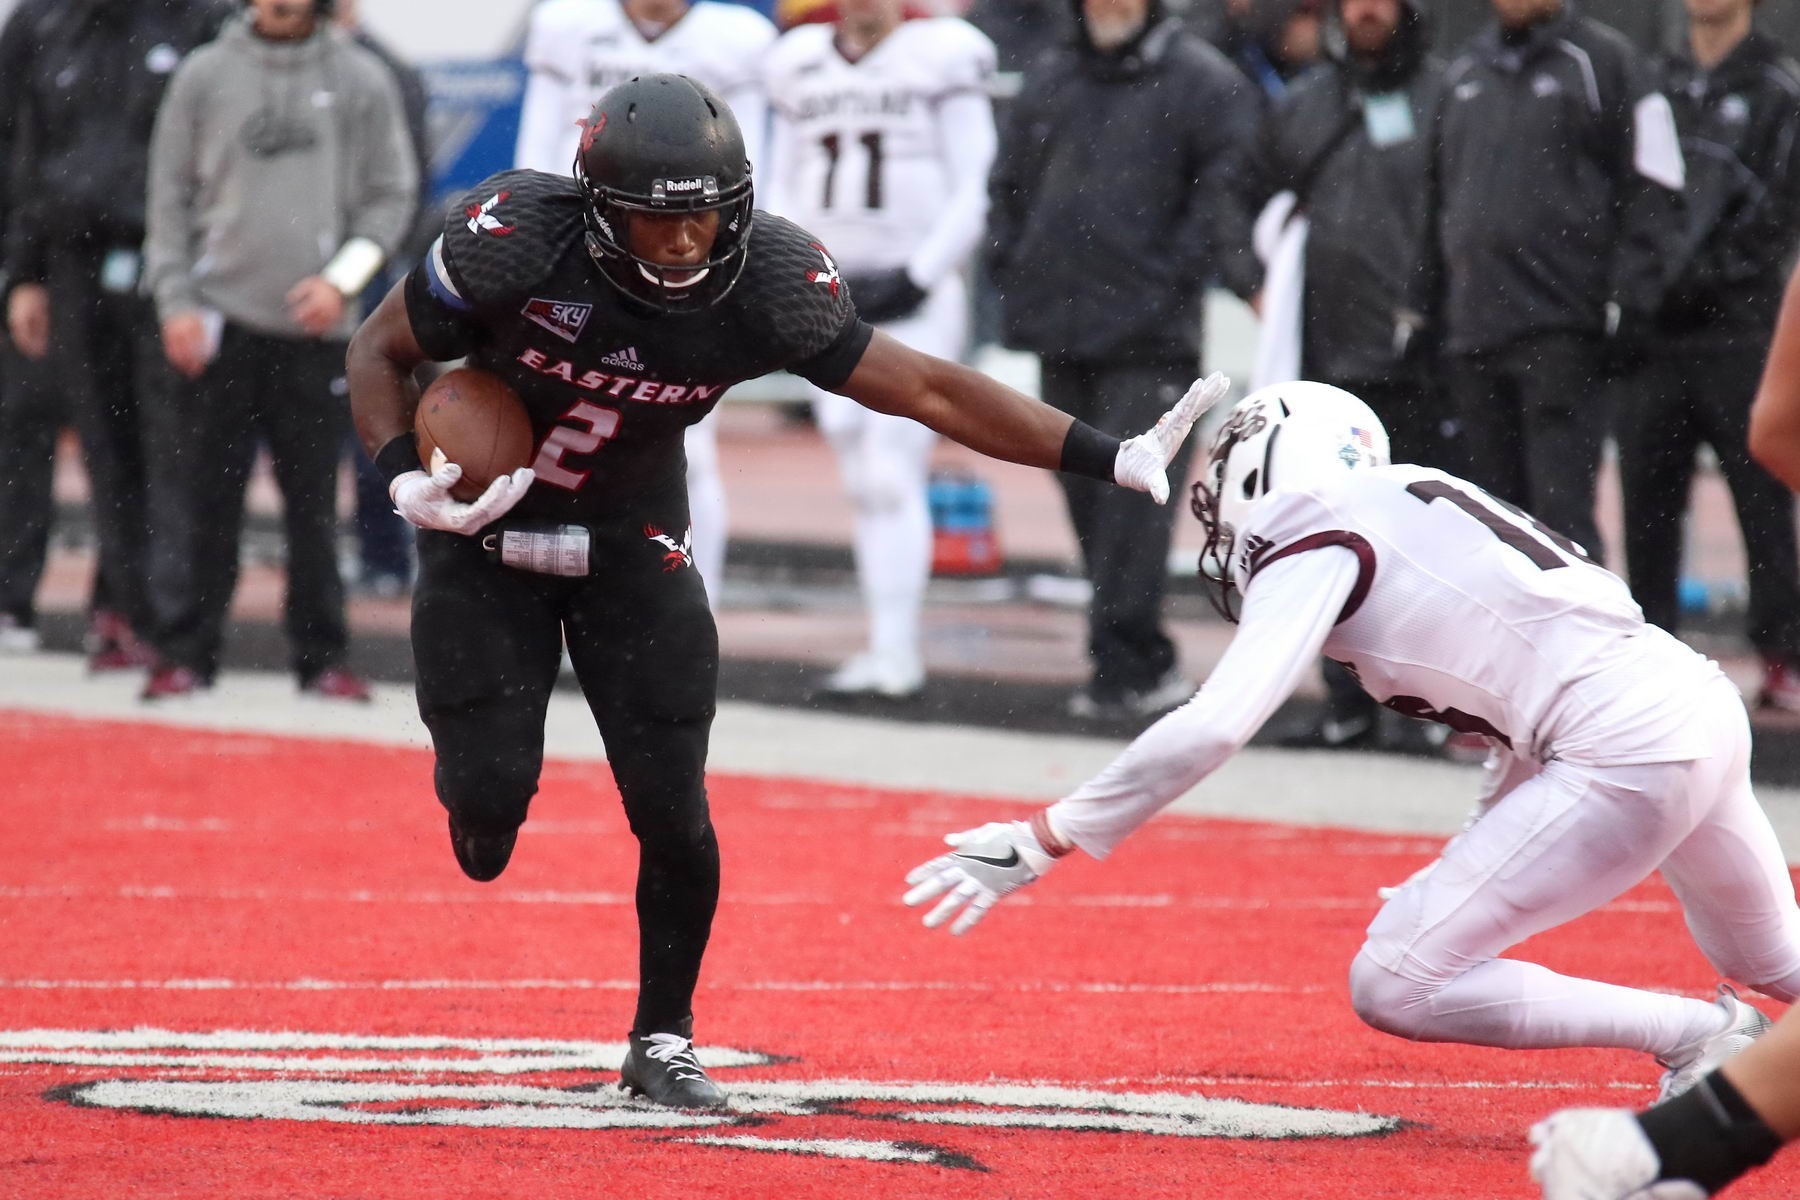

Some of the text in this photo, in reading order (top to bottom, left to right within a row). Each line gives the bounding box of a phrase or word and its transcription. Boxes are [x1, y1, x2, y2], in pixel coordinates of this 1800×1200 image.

[666, 178, 702, 191] Riddell
[820, 130, 882, 210] 11
[516, 348, 722, 404] EASTERN
[601, 356, 646, 372] adidas
[530, 398, 623, 491] 2
